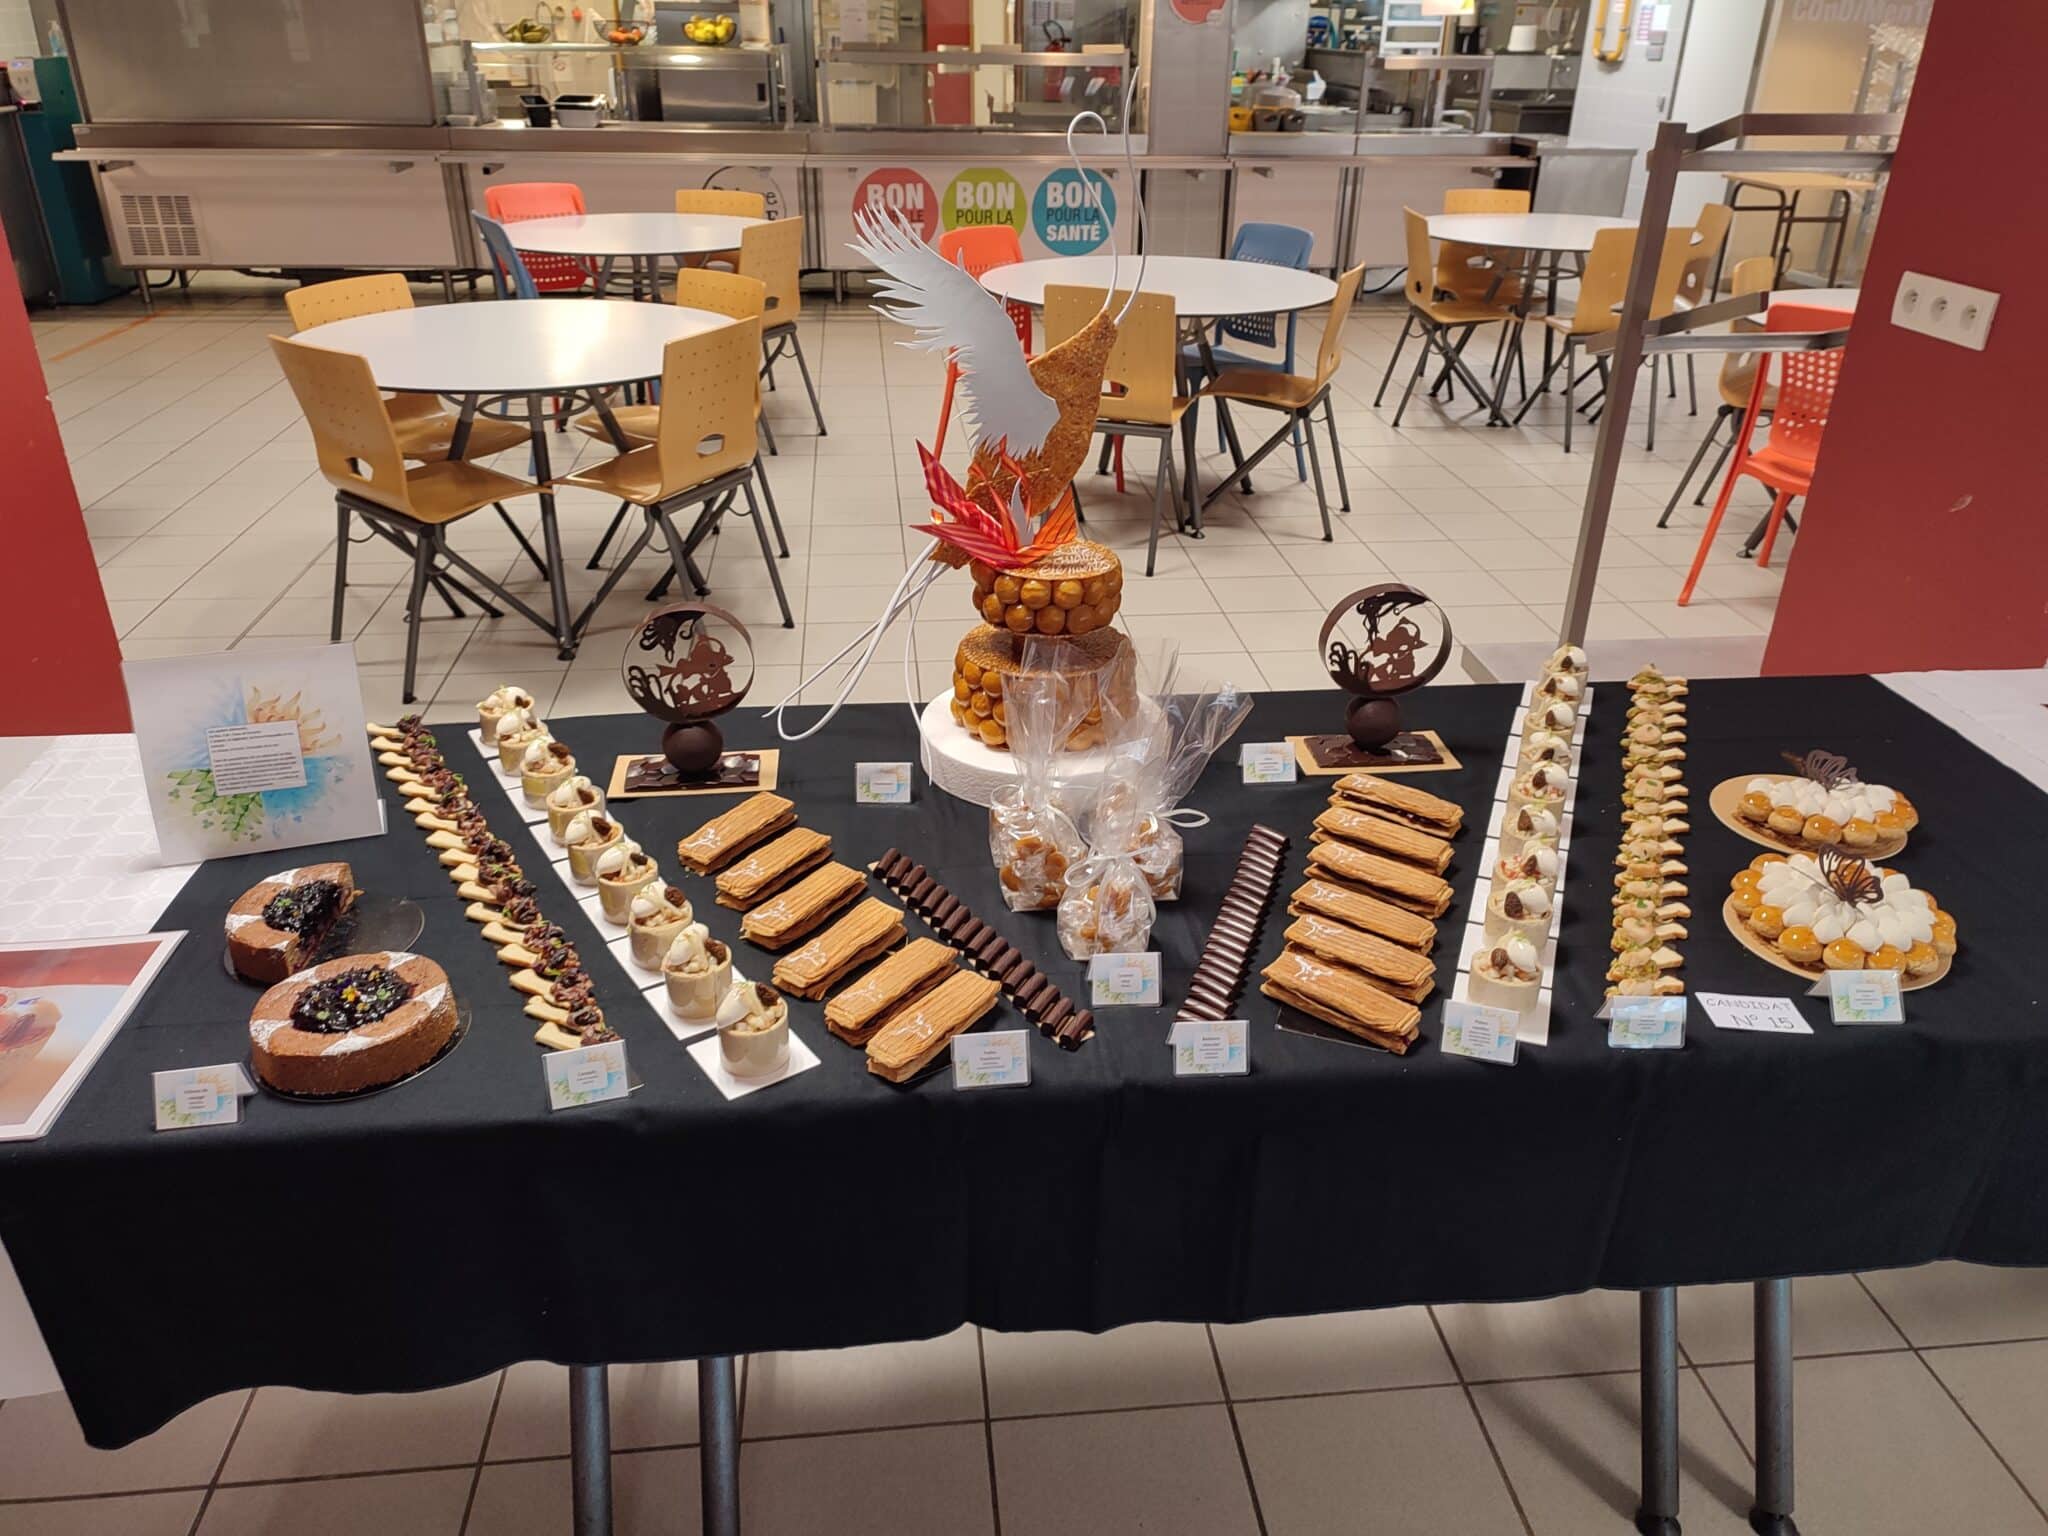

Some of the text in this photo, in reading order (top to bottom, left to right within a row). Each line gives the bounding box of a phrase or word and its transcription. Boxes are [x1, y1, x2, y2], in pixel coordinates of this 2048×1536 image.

[867, 183, 924, 209] BON
[956, 182, 1015, 209] BON
[1047, 182, 1102, 208] BON
[910, 209, 924, 222] LE
[956, 209, 1014, 224] POUR LA
[1046, 208, 1101, 221] POUR LA
[1046, 220, 1101, 241] SANTÉ
[1706, 998, 1791, 1011] CANDIDAT
[1768, 1016, 1795, 1030] 15
